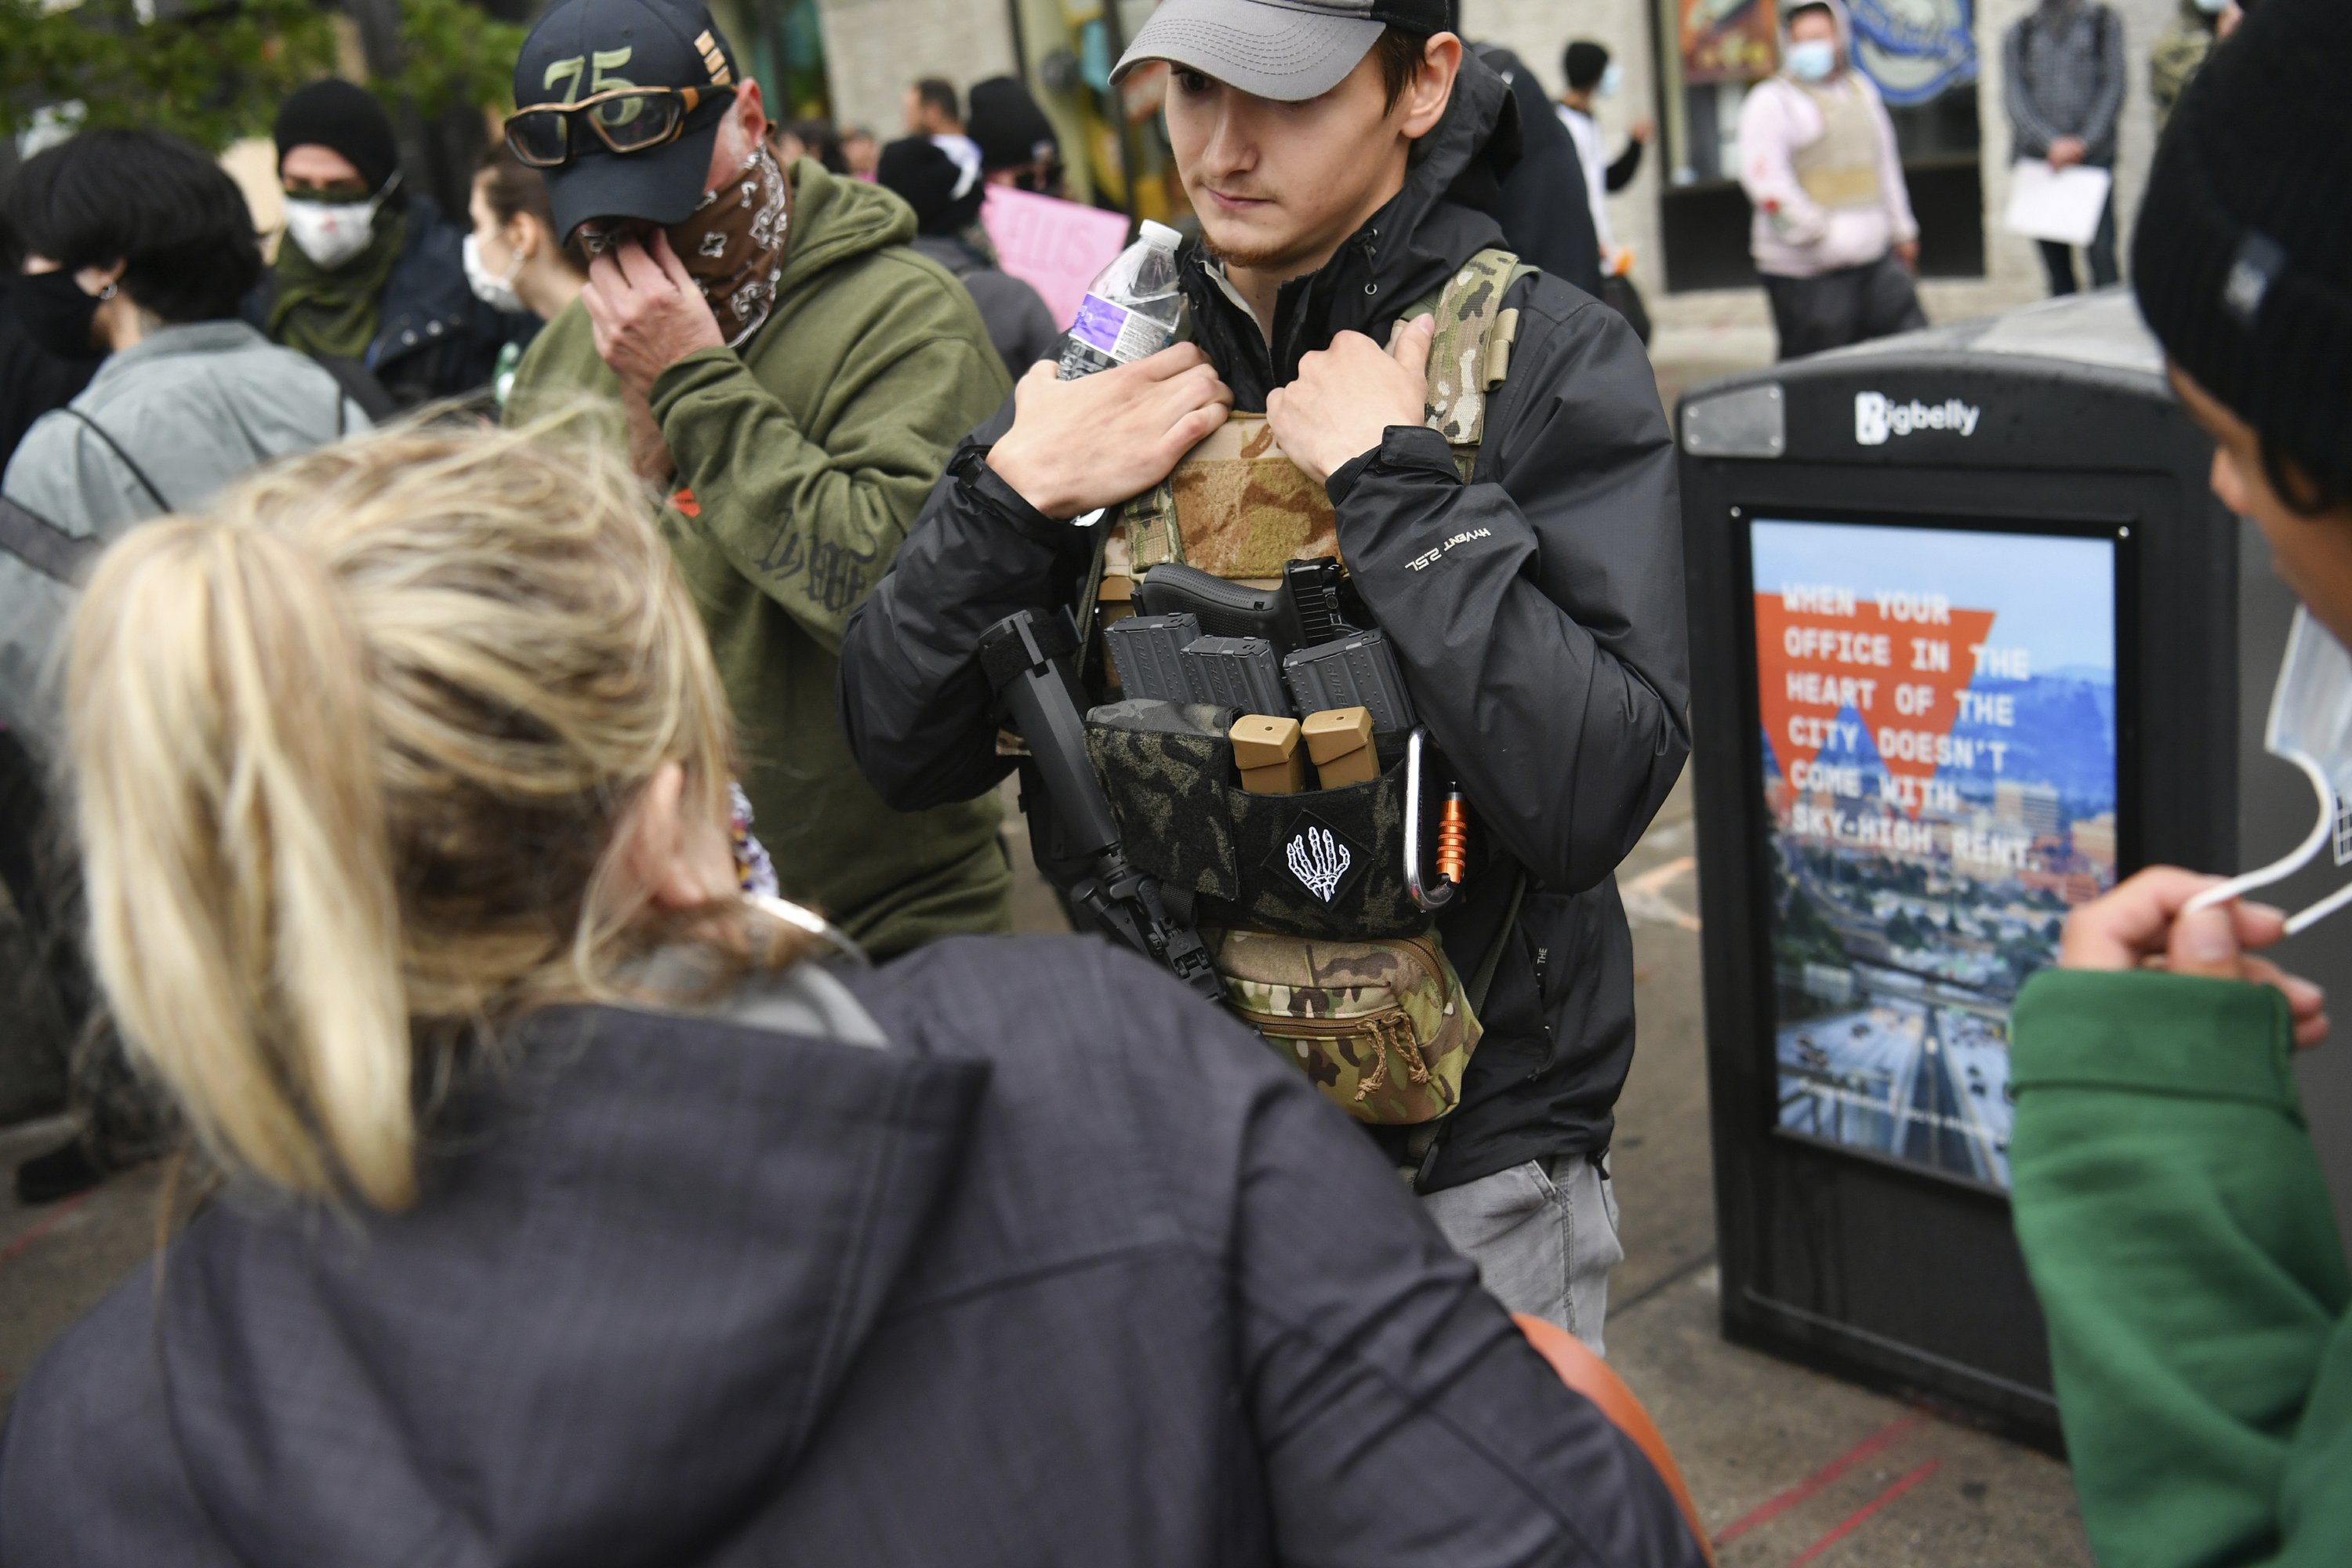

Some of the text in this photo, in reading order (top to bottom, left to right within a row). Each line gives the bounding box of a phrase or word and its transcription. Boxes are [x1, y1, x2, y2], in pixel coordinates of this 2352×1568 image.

[544, 45, 644, 141] 75
[1855, 391, 1980, 446] Bigbelly
[1404, 547, 1442, 571] 2.5L
[1783, 583, 1951, 625] WHEN YOUR
[1784, 626, 2031, 681] OFFICE IN THE
[1786, 672, 2015, 726] HEART OF THE
[1788, 716, 2007, 772] CITY DOESN'T
[1791, 759, 1958, 811] COME WITH
[1792, 804, 2040, 869] SKY-HIGH RENT.
[1537, 947, 1548, 964] THE
